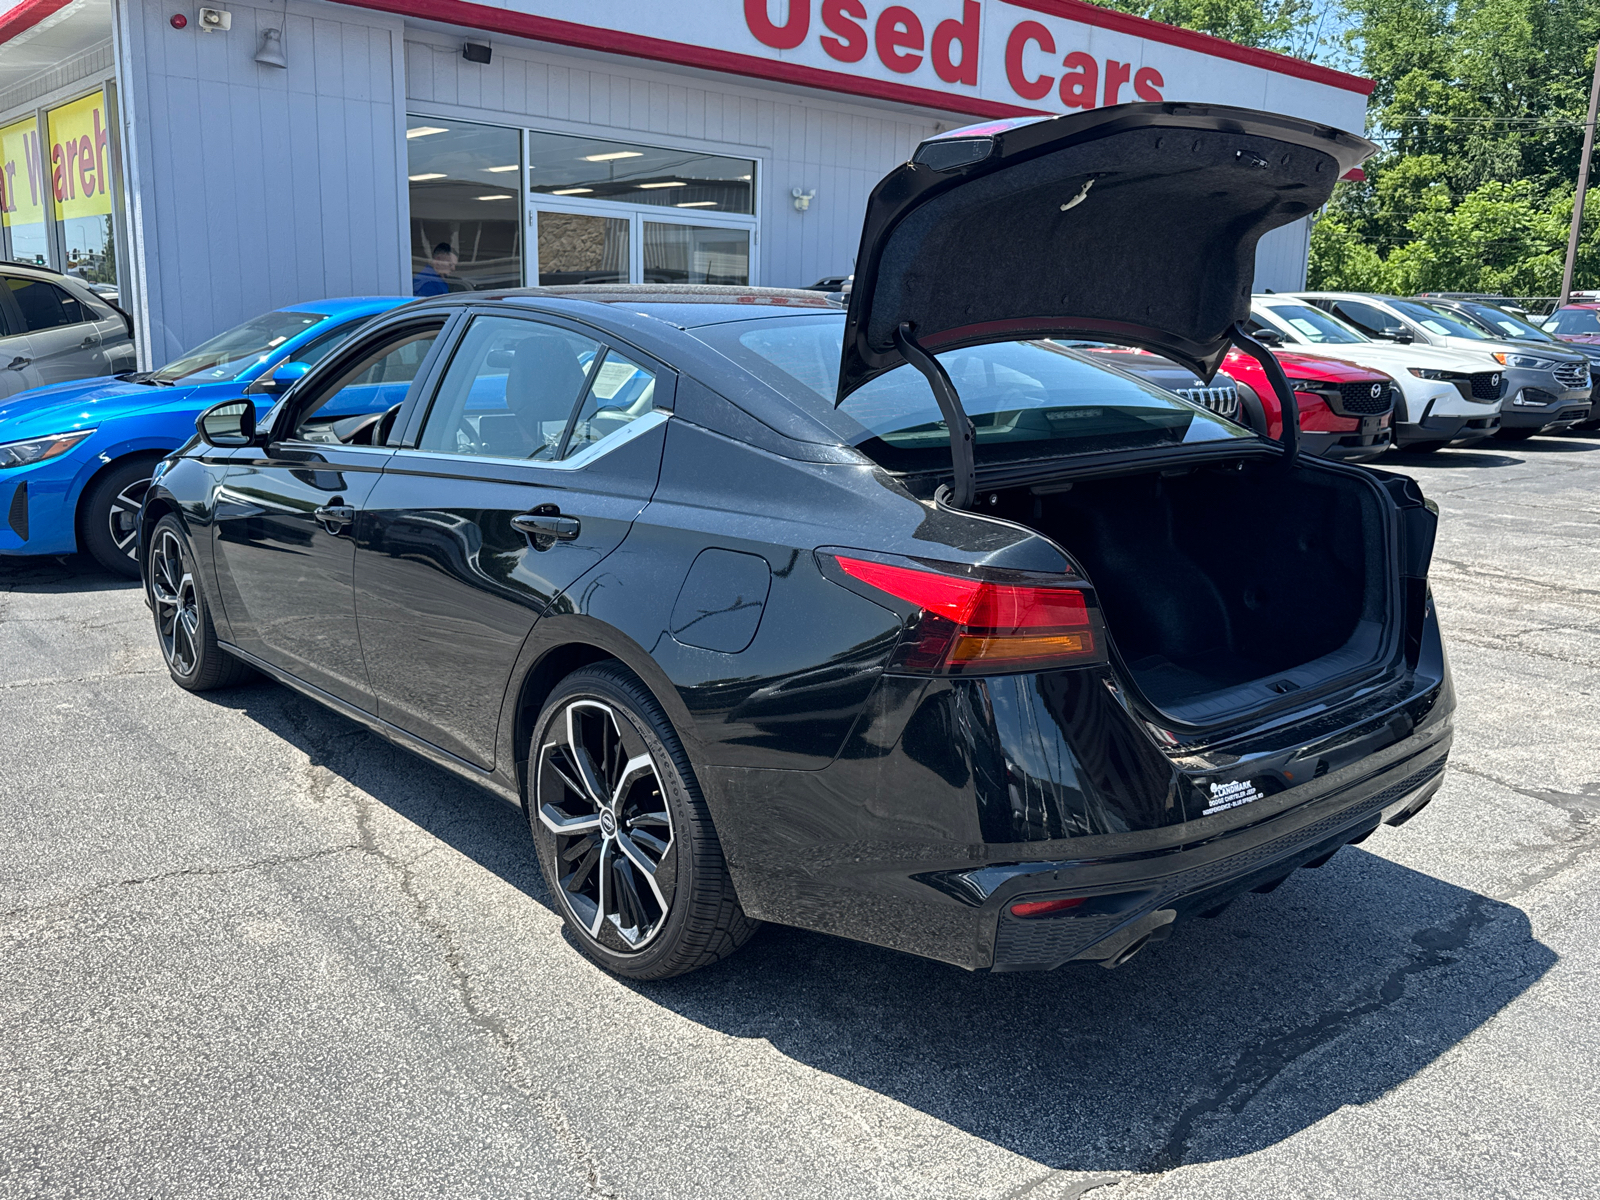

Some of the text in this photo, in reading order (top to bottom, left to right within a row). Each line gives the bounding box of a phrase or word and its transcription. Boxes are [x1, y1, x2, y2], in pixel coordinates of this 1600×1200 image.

[743, 0, 1164, 109] Used Cars
[653, 740, 685, 819] Firestone
[1209, 798, 1225, 807] DODGE
[1218, 780, 1252, 797] LANDMARK
